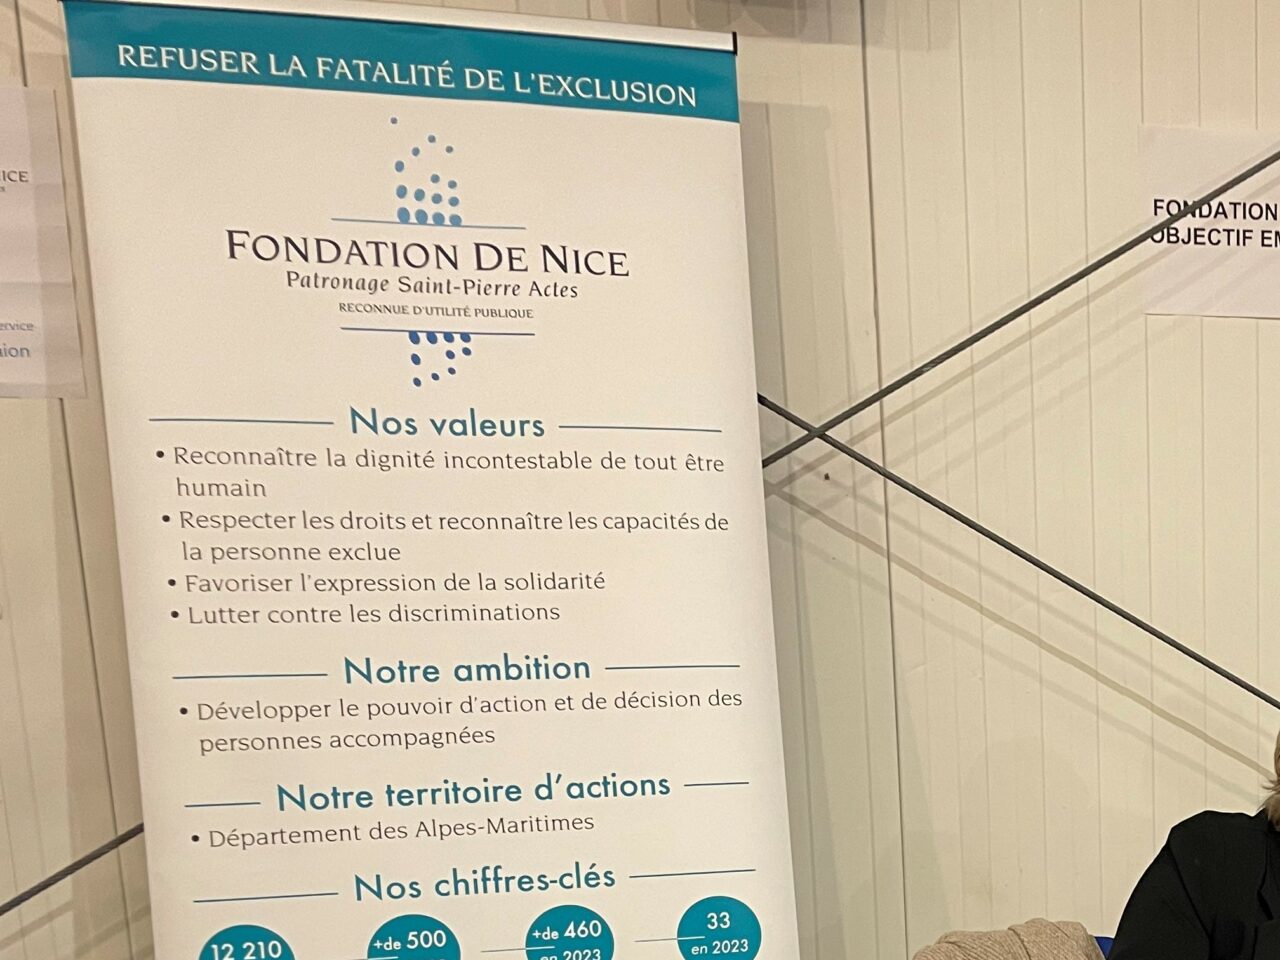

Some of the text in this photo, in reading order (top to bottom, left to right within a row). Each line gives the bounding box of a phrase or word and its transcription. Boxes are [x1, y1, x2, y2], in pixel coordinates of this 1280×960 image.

[118, 44, 696, 107] REFUSER LA FATALITÉ DE L'EXCLUSION
[225, 229, 629, 276] FONDATION DE NICE
[286, 270, 577, 298] Patronage Saint-Pierre Actes
[338, 302, 534, 318] RECONNUE D'UTILITÉ PUBLIQUE
[350, 408, 544, 437] Nos valeurs
[173, 446, 724, 472] Reconnaître la dignité incontestable de tout être
[176, 476, 266, 497] humain
[179, 509, 728, 533] Respecter les droits et reconnaître les capacités de
[182, 540, 400, 564] la personne exclue
[185, 571, 605, 596] Favoriser l'expression de la solidarité
[188, 603, 560, 624] Lutter contre les discriminations
[344, 653, 590, 684] Notre ambition
[197, 688, 742, 722] Développer le pouvoir d'action et de décision des
[199, 725, 495, 756] personnes accompagnées
[277, 772, 670, 811] Notre territoire d'actions
[208, 814, 594, 850] Département des Alpes-Maritimes
[354, 860, 615, 901] Nos chiffres-clés
[532, 919, 601, 941] +de 460
[706, 911, 730, 929] 33
[242, 940, 281, 960] 210
[372, 929, 446, 952] +de 500
[691, 938, 748, 955] en 2023
